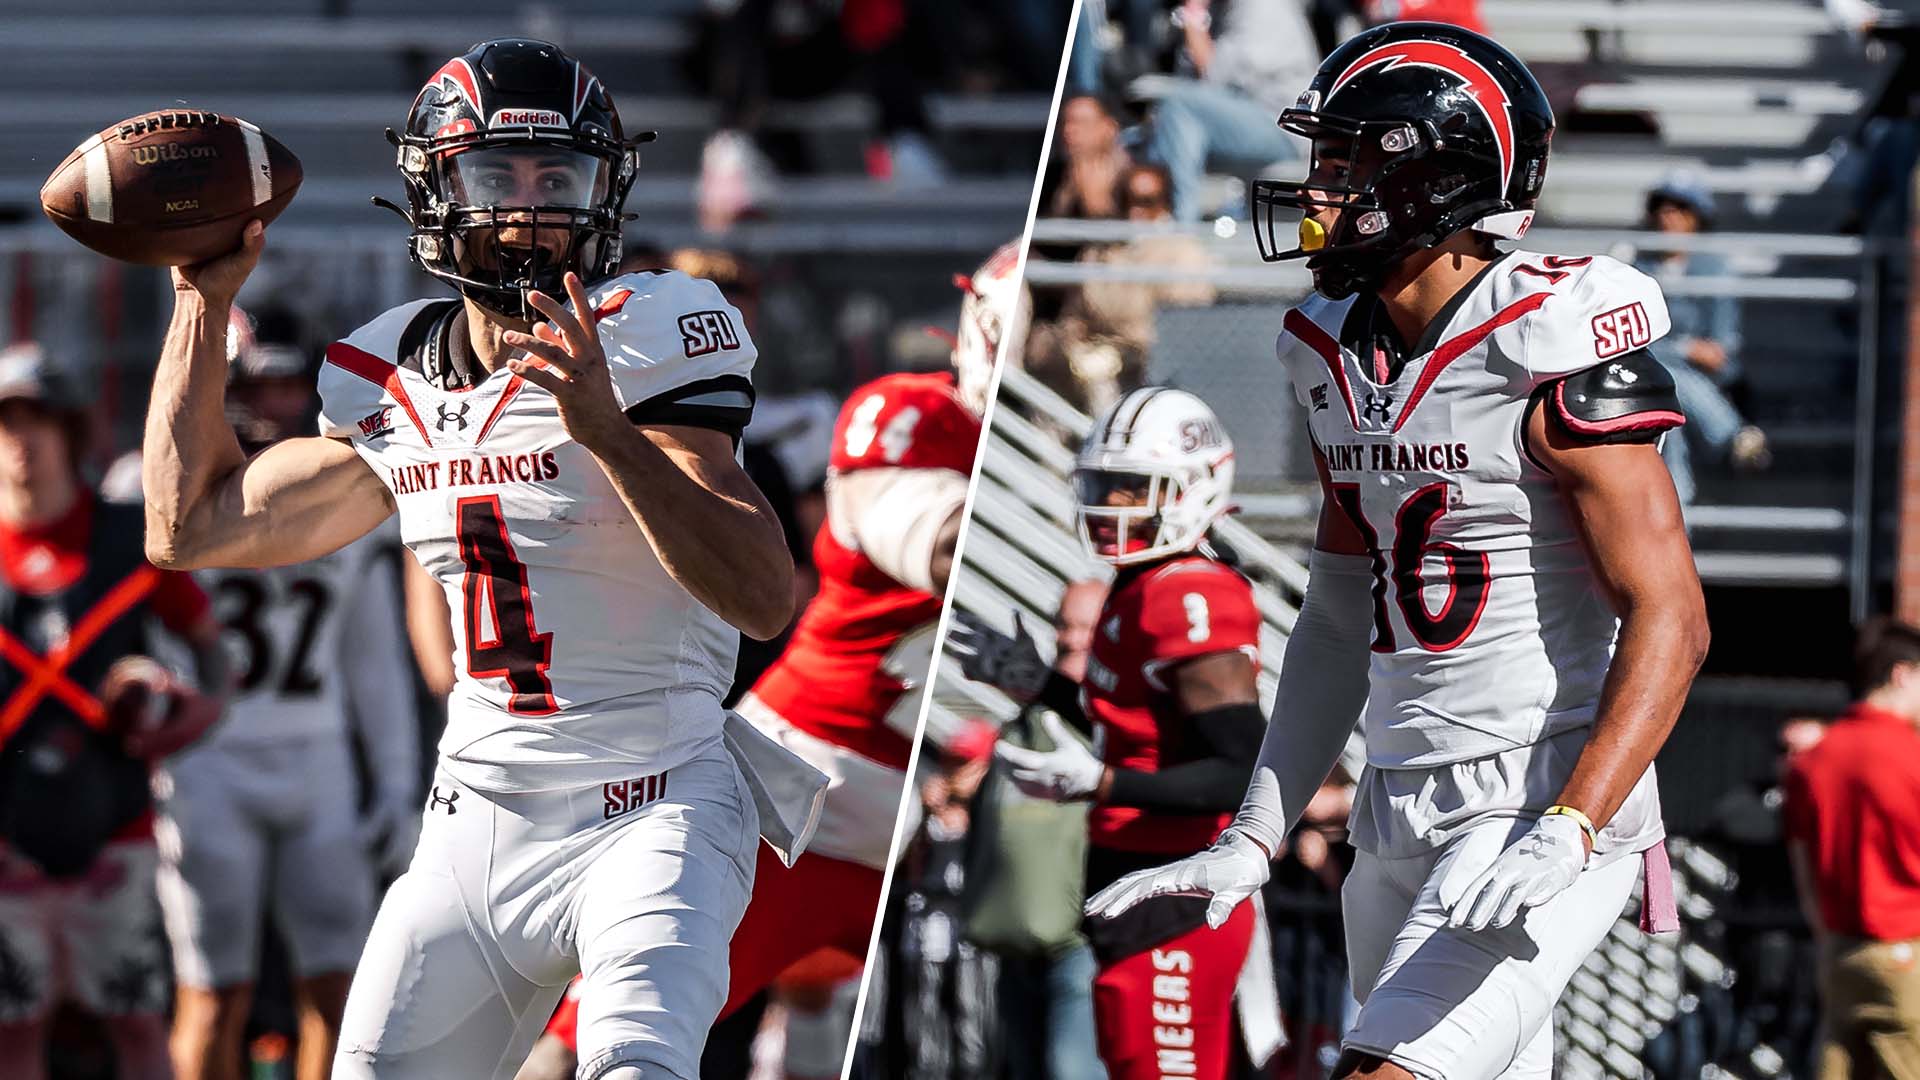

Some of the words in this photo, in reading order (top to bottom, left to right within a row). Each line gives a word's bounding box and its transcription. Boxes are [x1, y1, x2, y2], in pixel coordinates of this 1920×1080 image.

[500, 111, 560, 126] Riddell
[132, 140, 217, 167] Wilson
[164, 199, 200, 213] NCAA
[678, 310, 741, 360] SFU
[1591, 301, 1652, 359] SFU
[356, 406, 393, 437] NEC
[448, 451, 561, 488] FRANCIS
[1322, 443, 1365, 472] AINT
[1370, 442, 1470, 472] FRANCIS
[1329, 481, 1492, 652] 16
[456, 493, 562, 717] 4
[216, 575, 331, 699] 32
[1151, 947, 1197, 1080] NEERS
